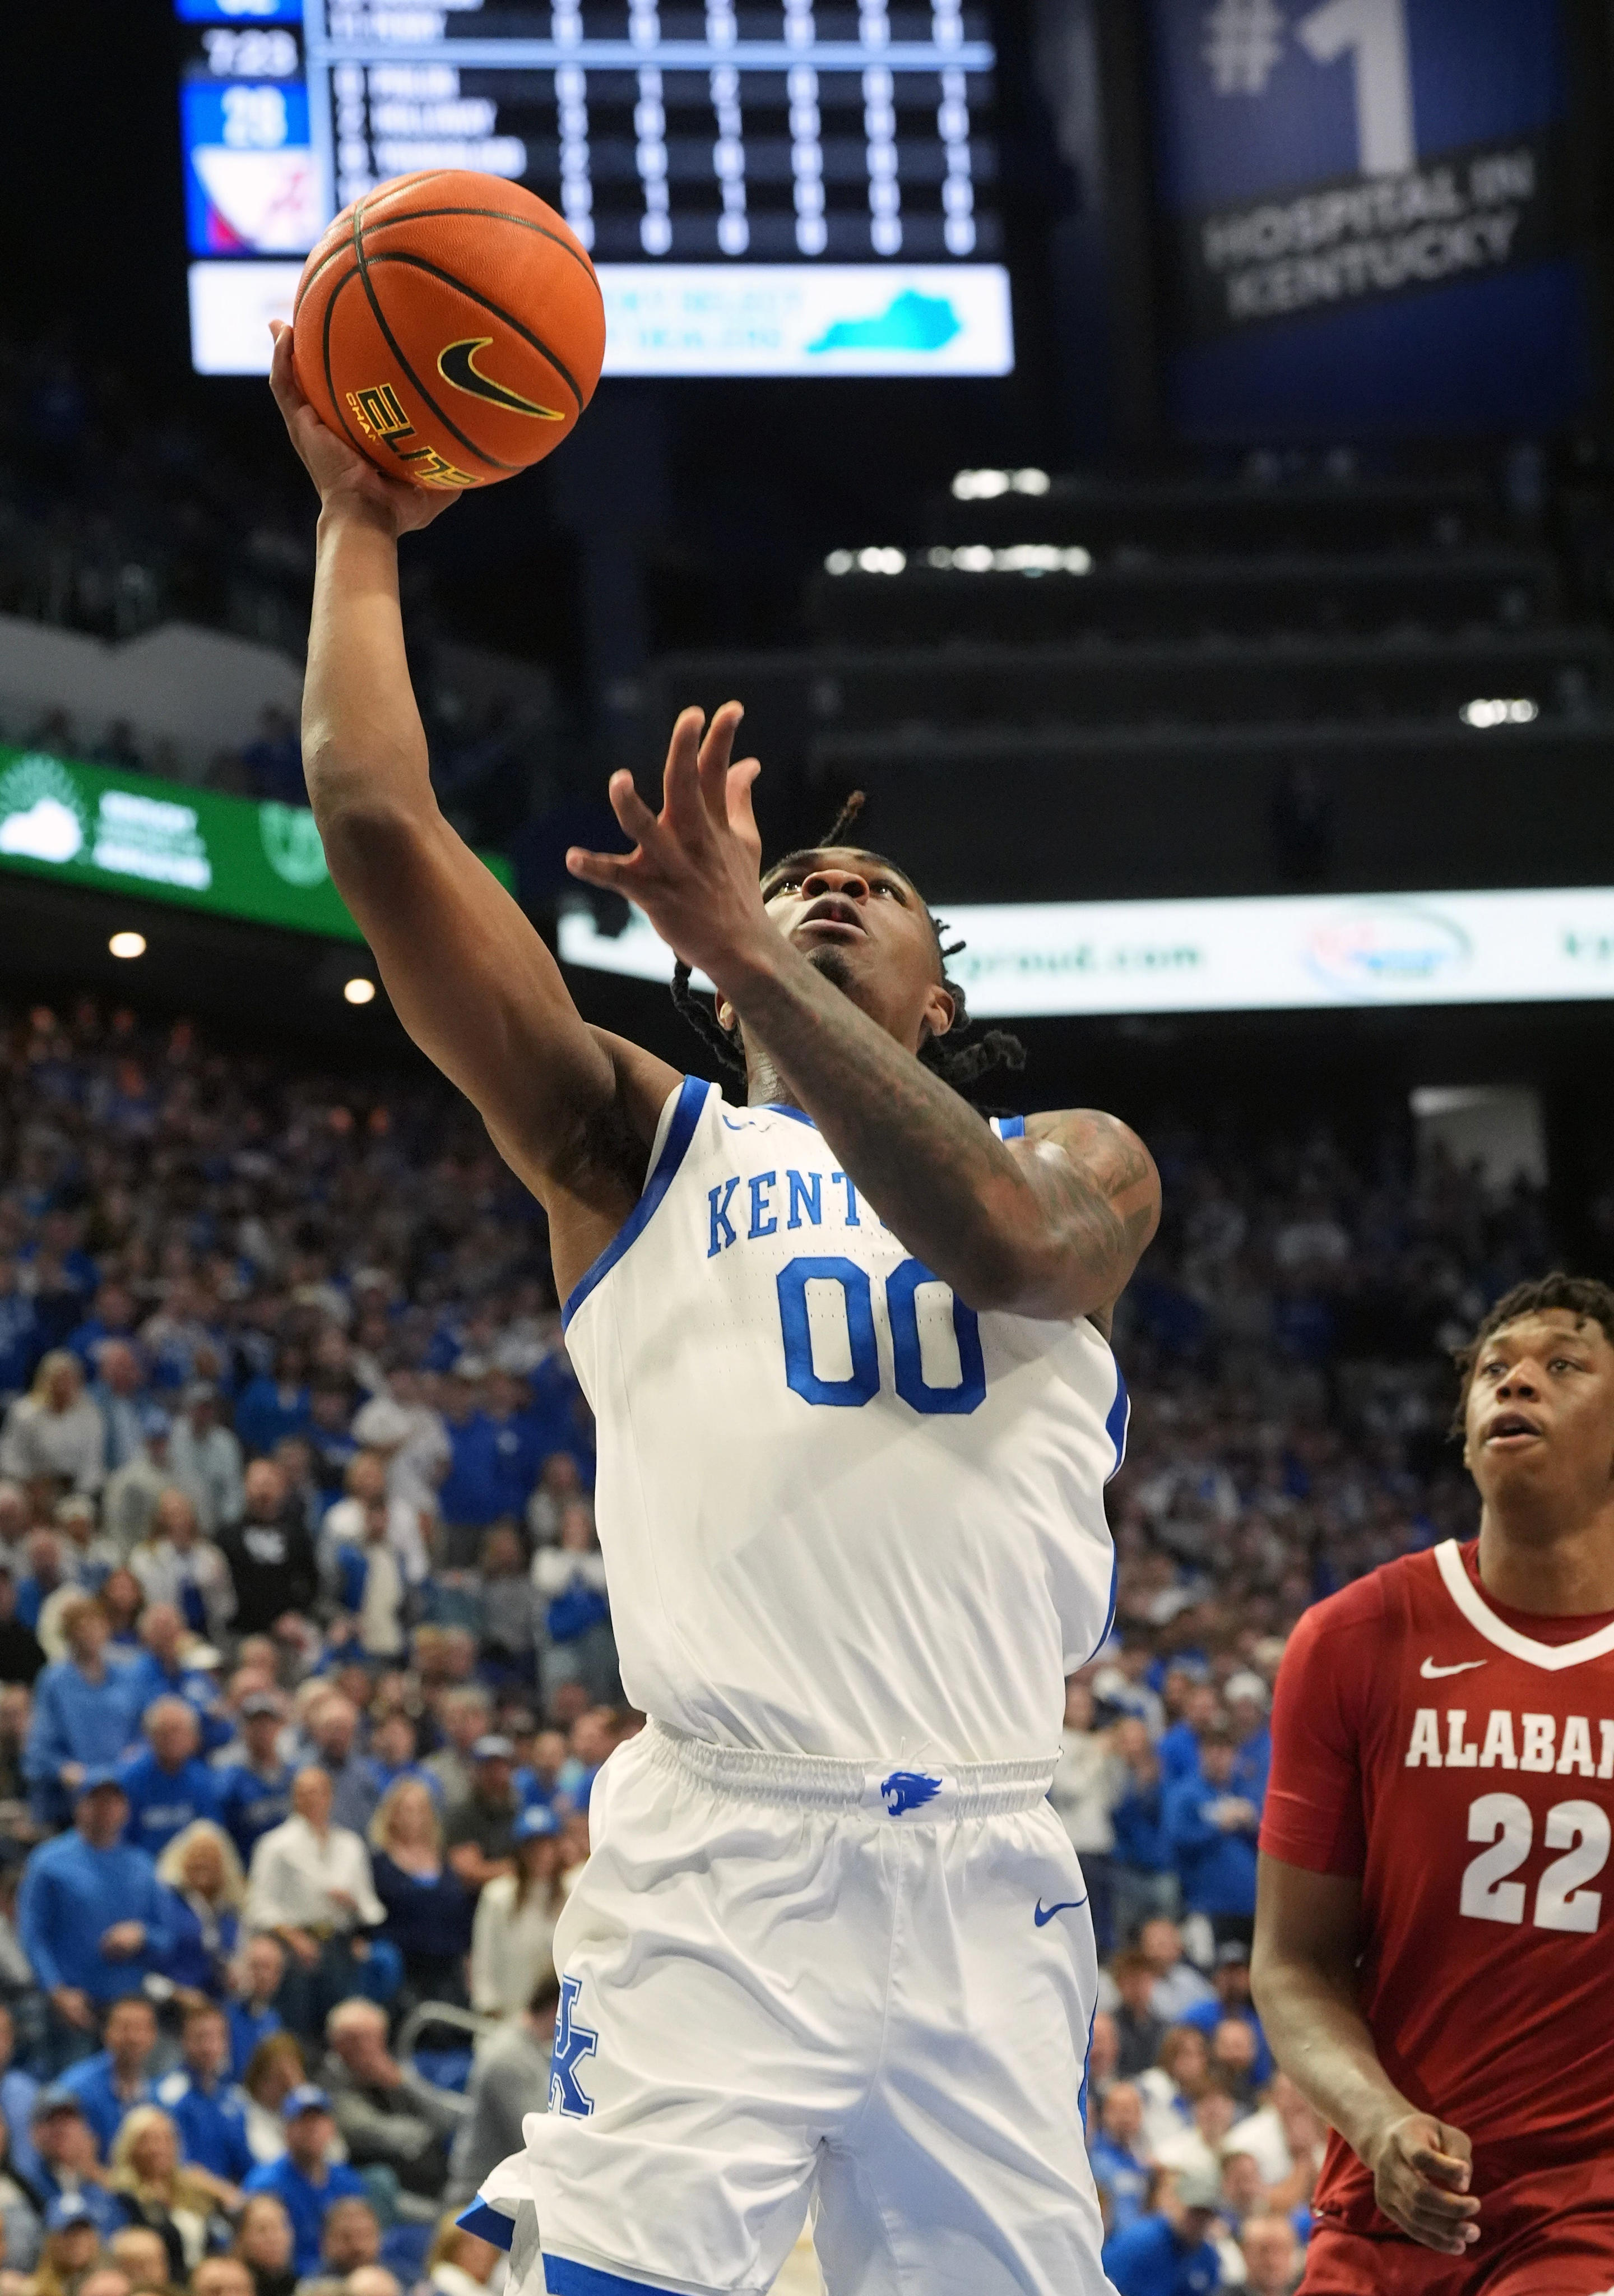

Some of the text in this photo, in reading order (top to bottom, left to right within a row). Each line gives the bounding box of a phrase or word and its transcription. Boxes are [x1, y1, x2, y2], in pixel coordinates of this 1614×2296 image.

[1203, 168, 1464, 271] HOSPITAL
[1228, 211, 1516, 317] KENTUCKY
[355, 383, 484, 487] ELITE
[707, 1170, 887, 1258] KENT
[776, 1256, 986, 1415] 00
[1459, 1792, 1612, 1933] 22
